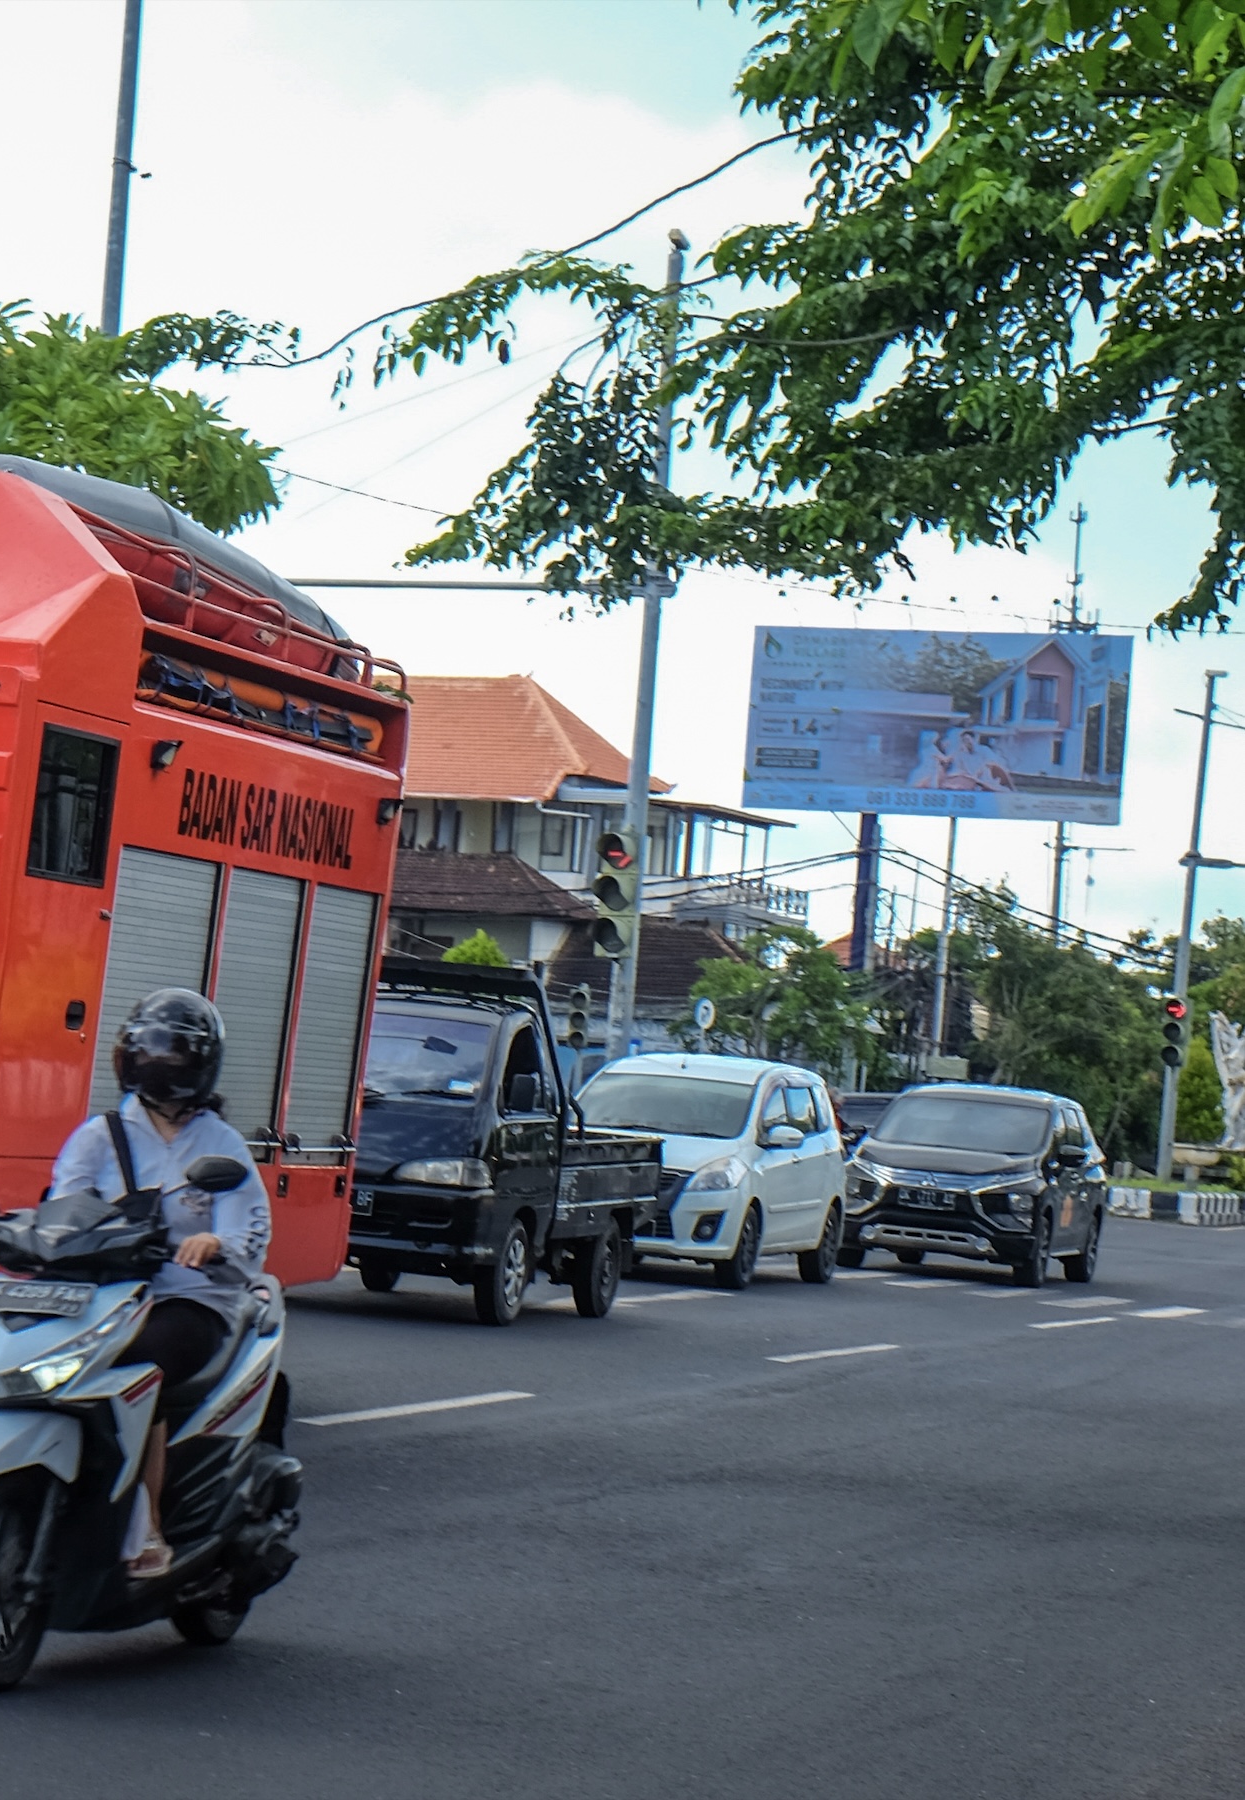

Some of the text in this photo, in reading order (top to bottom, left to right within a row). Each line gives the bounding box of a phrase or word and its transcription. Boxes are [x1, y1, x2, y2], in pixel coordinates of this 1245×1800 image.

[178, 768, 354, 869] BADAN SAR NASIONAL
